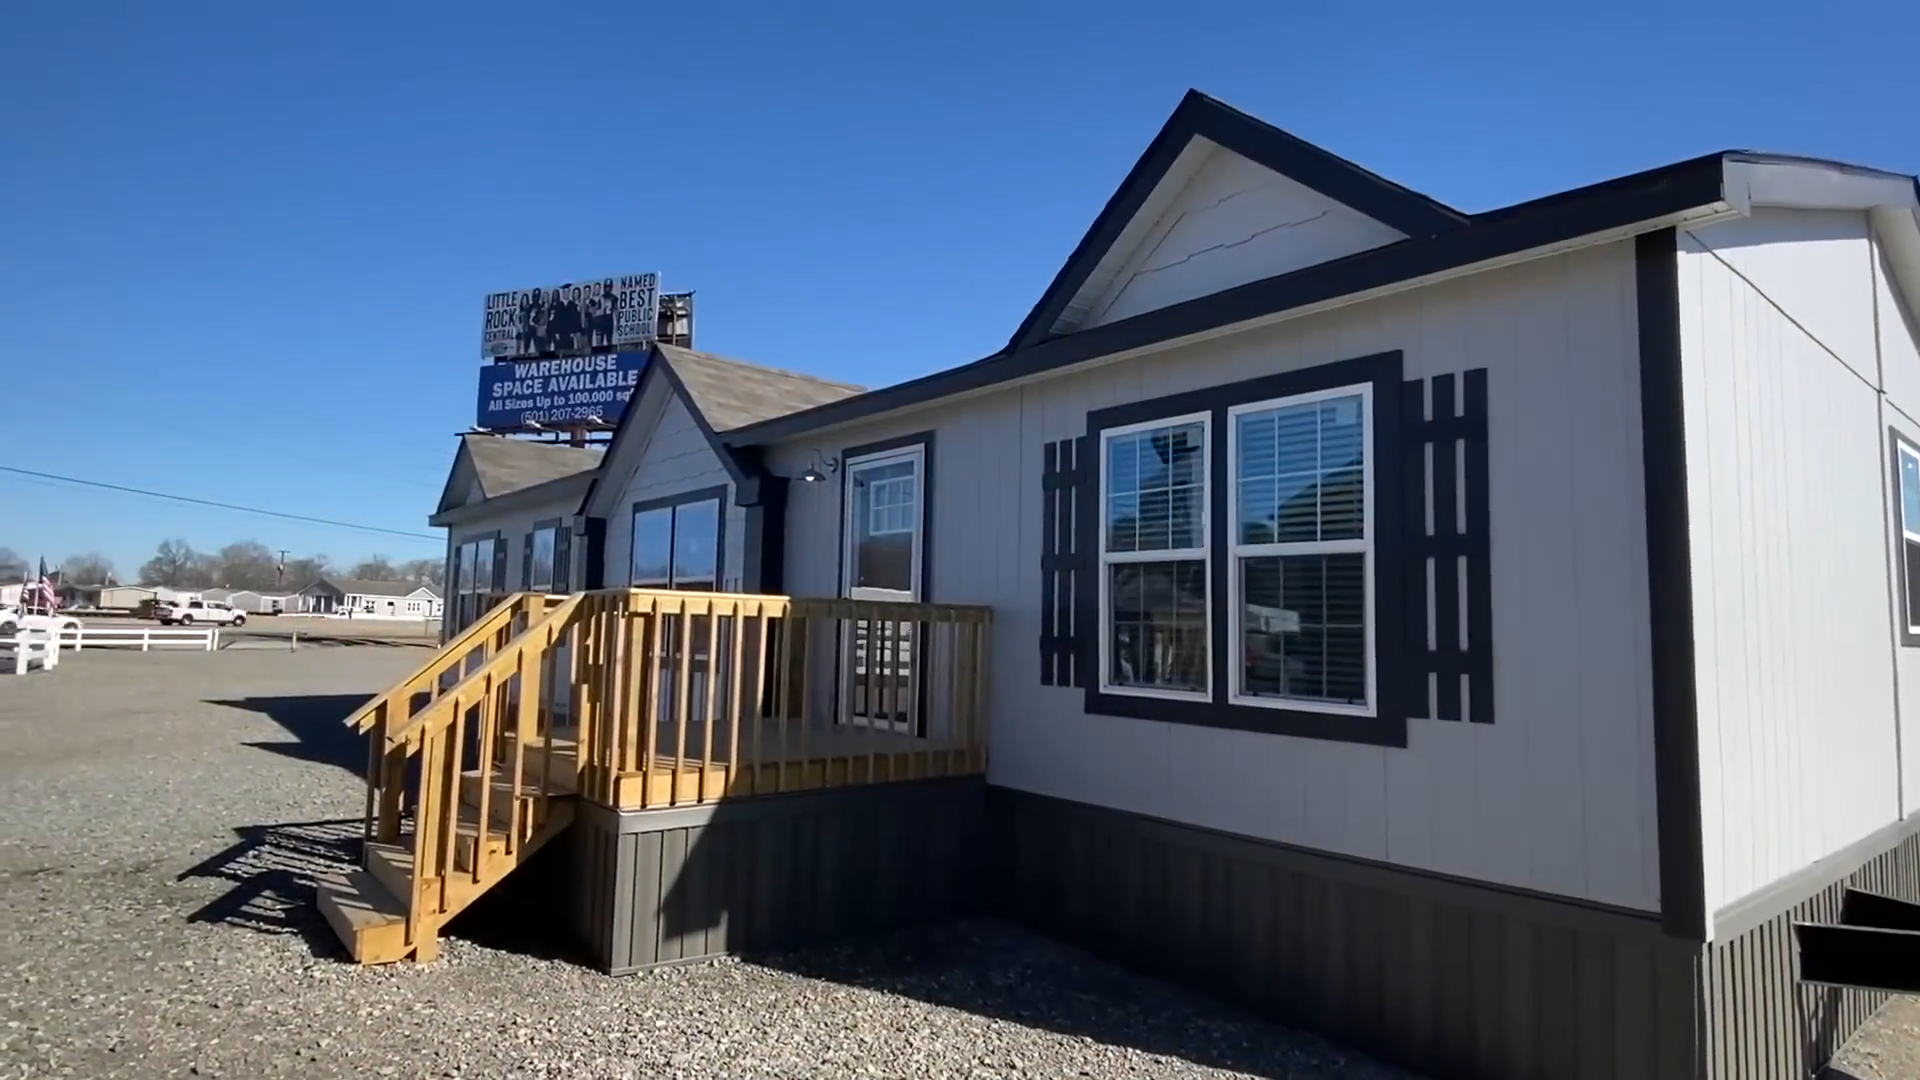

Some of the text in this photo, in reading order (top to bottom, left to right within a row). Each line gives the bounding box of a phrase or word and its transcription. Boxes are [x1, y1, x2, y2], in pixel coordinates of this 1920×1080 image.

[620, 273, 656, 289] NAMED
[487, 291, 517, 309] LITTLE
[619, 288, 655, 309] BEST
[485, 308, 516, 330] ROCK
[617, 307, 654, 322] PUBLIC
[617, 321, 651, 336] SCHOOL
[514, 354, 618, 379] WAREHOUSE
[492, 370, 638, 397] SPACE AVAILABLE
[489, 399, 503, 411] All
[504, 398, 534, 410] Sizes
[536, 395, 551, 408] Up
[554, 394, 565, 406] to
[520, 406, 603, 424] (501) 207-2965
